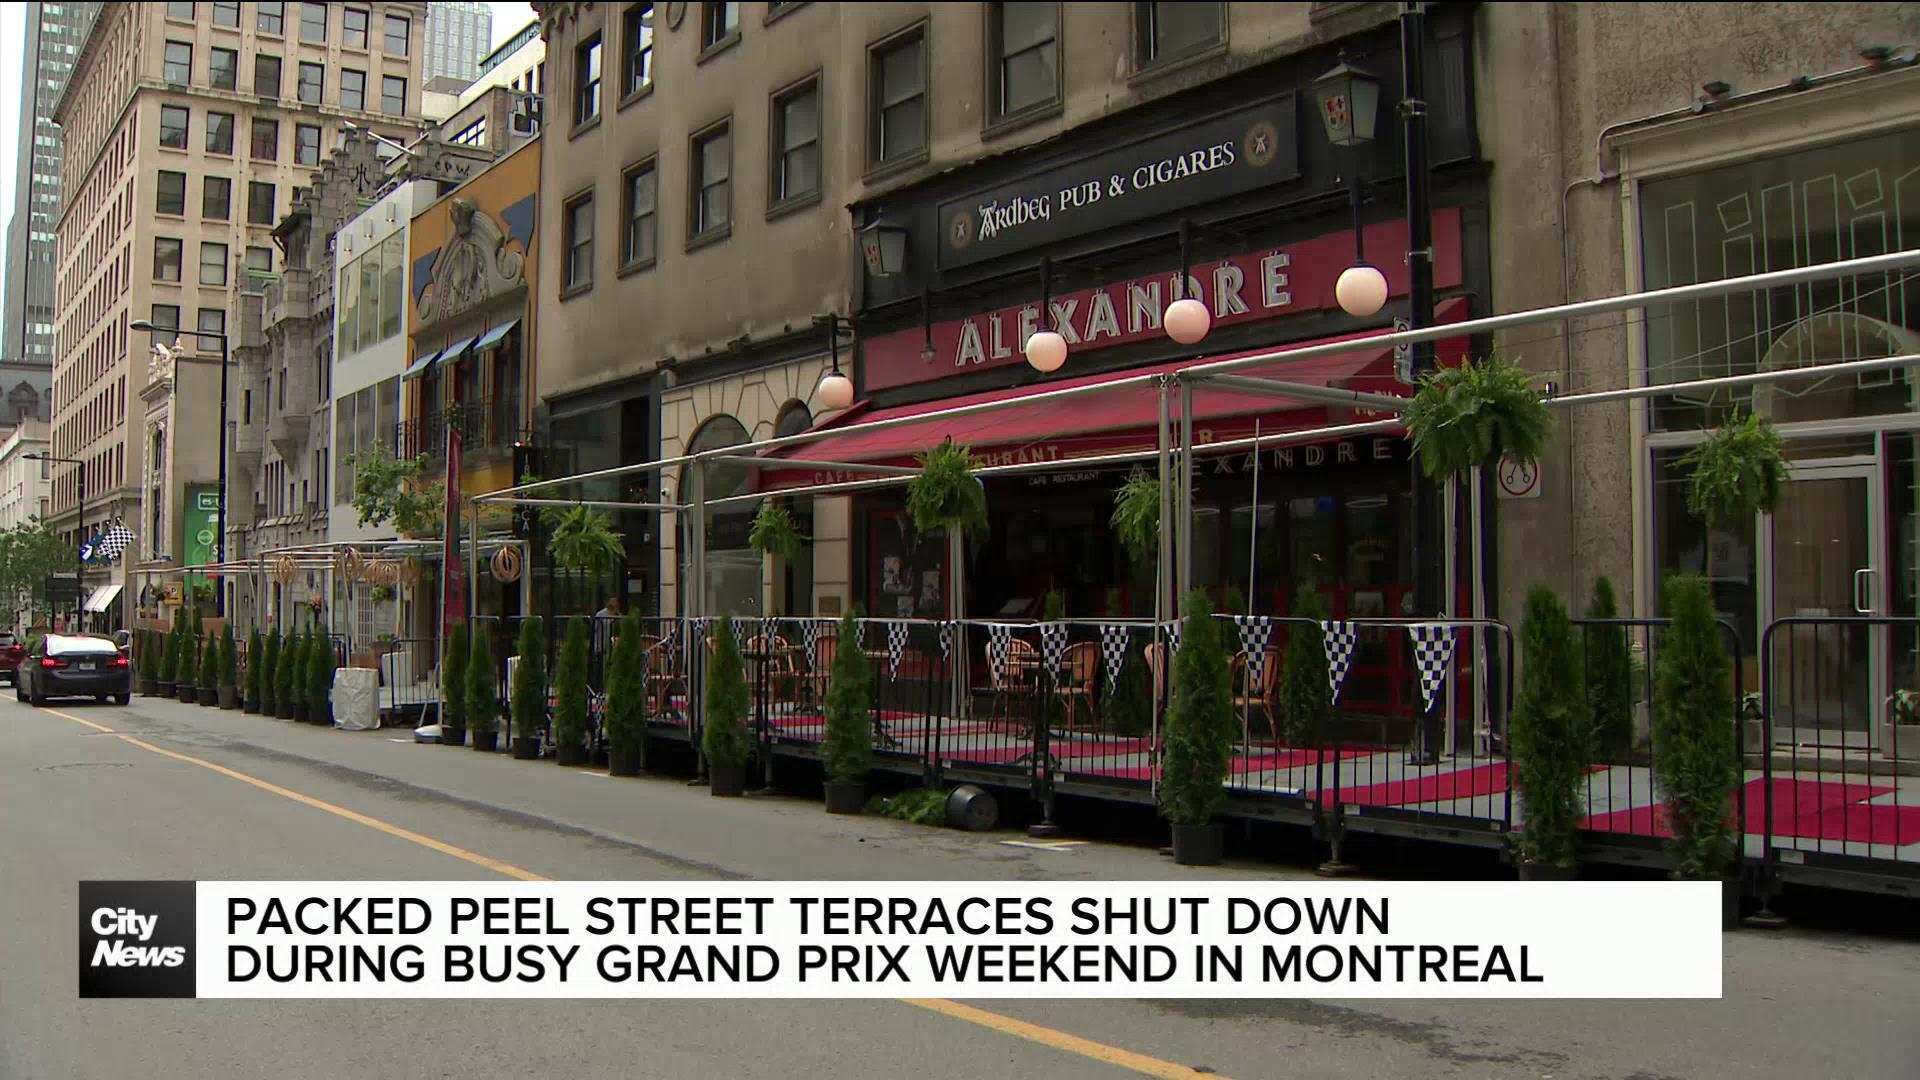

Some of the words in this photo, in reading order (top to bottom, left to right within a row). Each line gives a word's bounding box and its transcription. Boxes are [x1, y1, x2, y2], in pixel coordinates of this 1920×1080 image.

[978, 195, 1051, 242] Ardbeg
[1058, 180, 1101, 213] PUB
[1108, 174, 1126, 198] &
[1131, 140, 1236, 190] CIGARES
[1127, 438, 1394, 481] AEXANDRE
